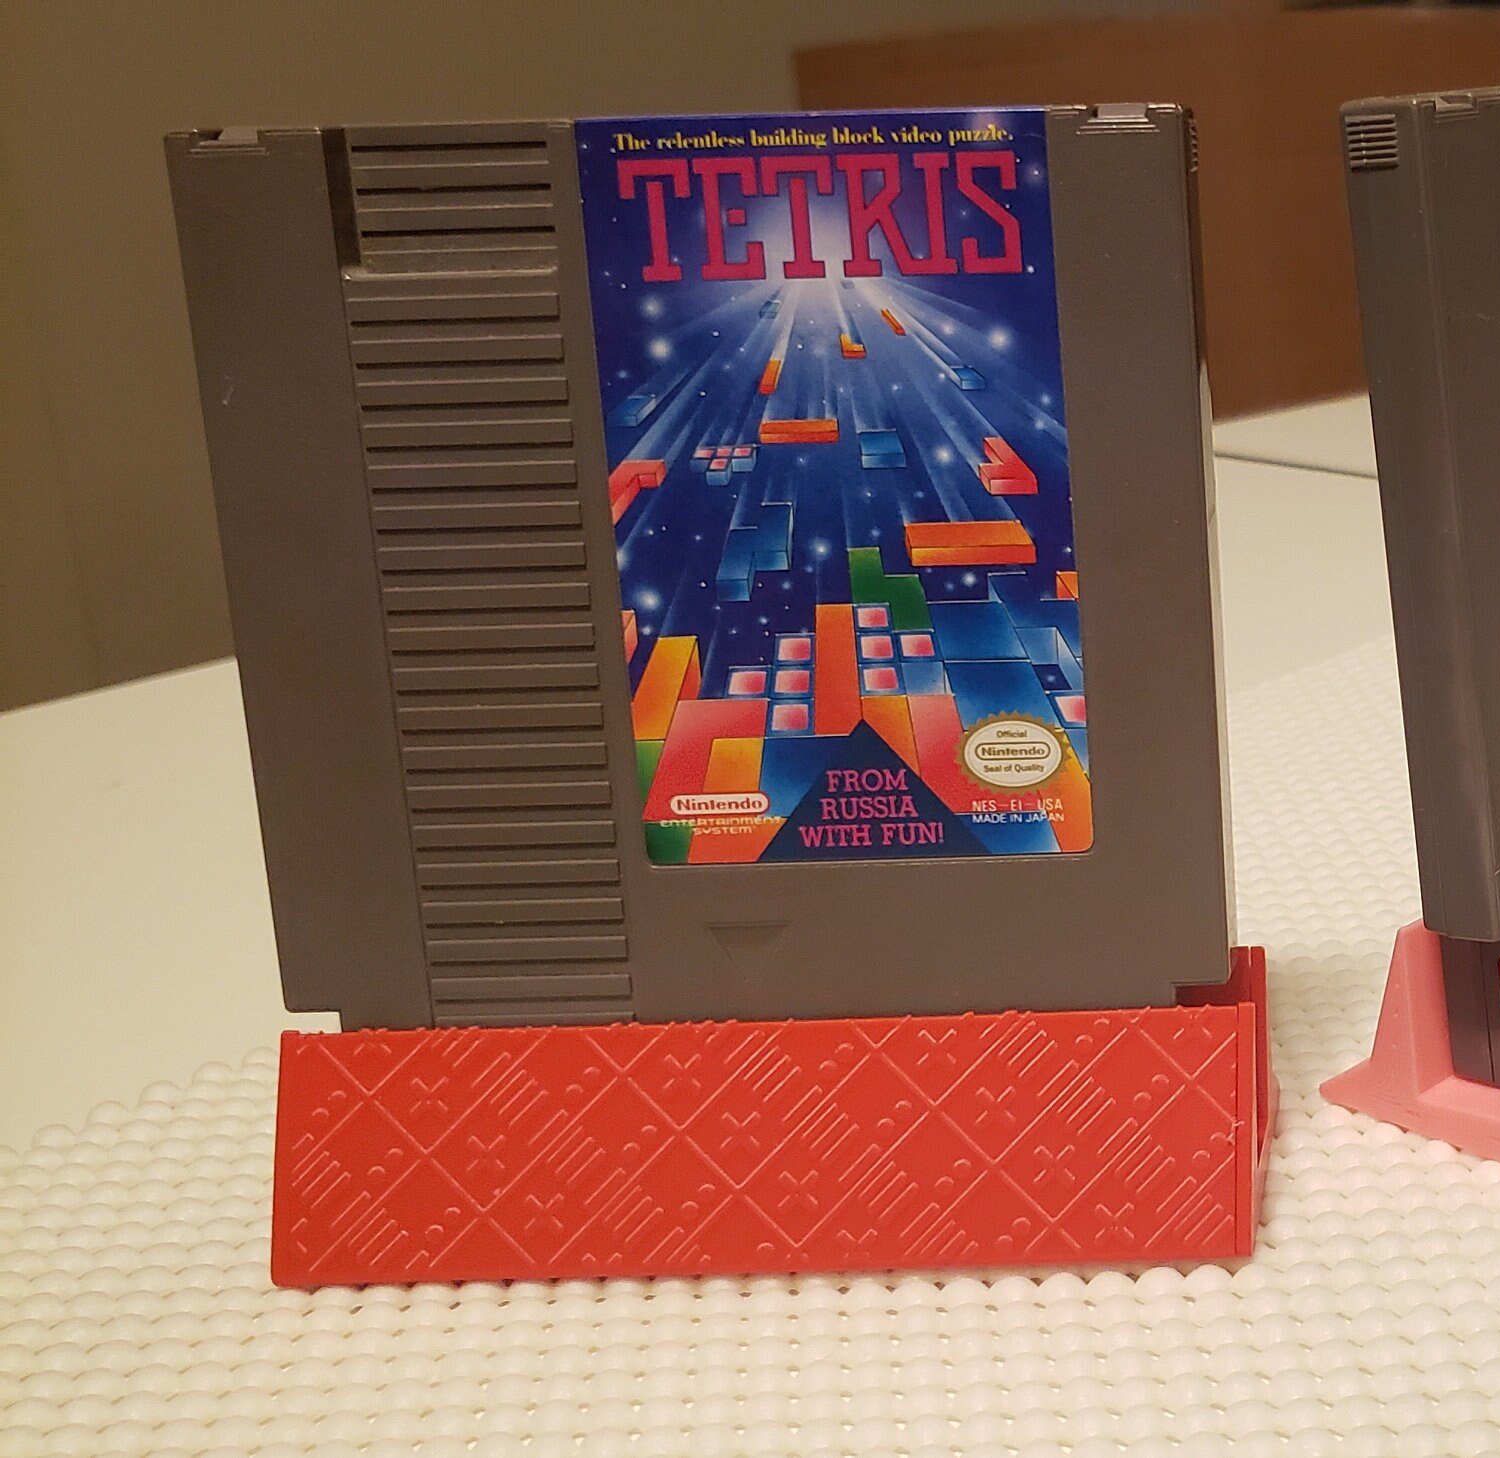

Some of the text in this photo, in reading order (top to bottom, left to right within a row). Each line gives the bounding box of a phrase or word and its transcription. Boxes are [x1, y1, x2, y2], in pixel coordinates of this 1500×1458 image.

[614, 123, 1014, 151] The relentless building block video puzzle.
[617, 150, 1023, 283] TETRIS
[981, 745, 1046, 757] Nintendo
[826, 768, 909, 794] FROM
[984, 764, 1002, 773] Seal
[676, 797, 763, 811] Nintendo
[820, 795, 919, 821] RUSSIA
[972, 812, 1065, 824] MADE IN JAPAN
[798, 820, 945, 849] WITH FUN!
